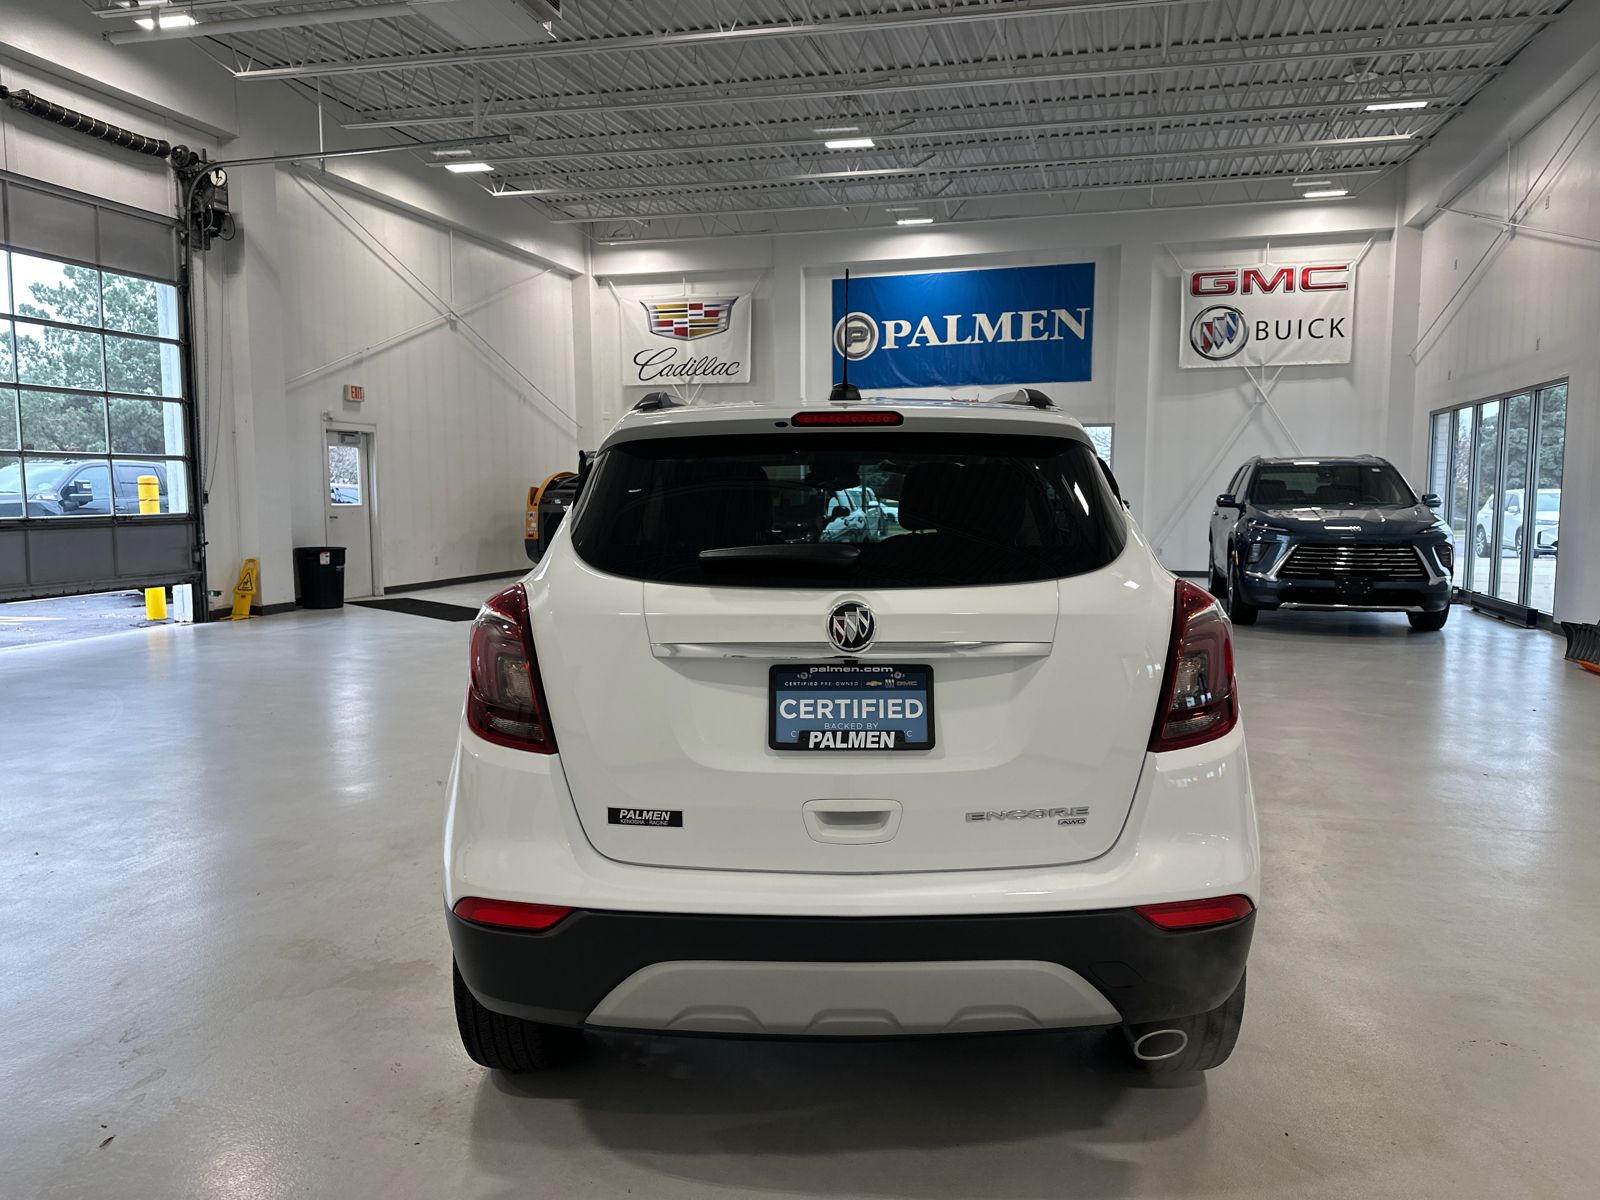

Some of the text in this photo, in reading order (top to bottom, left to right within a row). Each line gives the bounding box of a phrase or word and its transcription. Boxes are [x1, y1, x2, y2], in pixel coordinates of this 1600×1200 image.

[1190, 263, 1349, 297] GMC
[881, 307, 1091, 349] PALMEN
[1255, 317, 1345, 341] BUICK
[633, 347, 740, 381] Cadillac
[351, 386, 362, 400] EXIT
[810, 665, 893, 674] palmen.com
[779, 698, 924, 719] CERTIFIED
[824, 722, 879, 730] BACKED BY
[808, 731, 895, 749] PALMEN
[619, 809, 670, 821] PALMEN
[965, 806, 1089, 822] ENCORE
[1059, 818, 1086, 826] AWD
